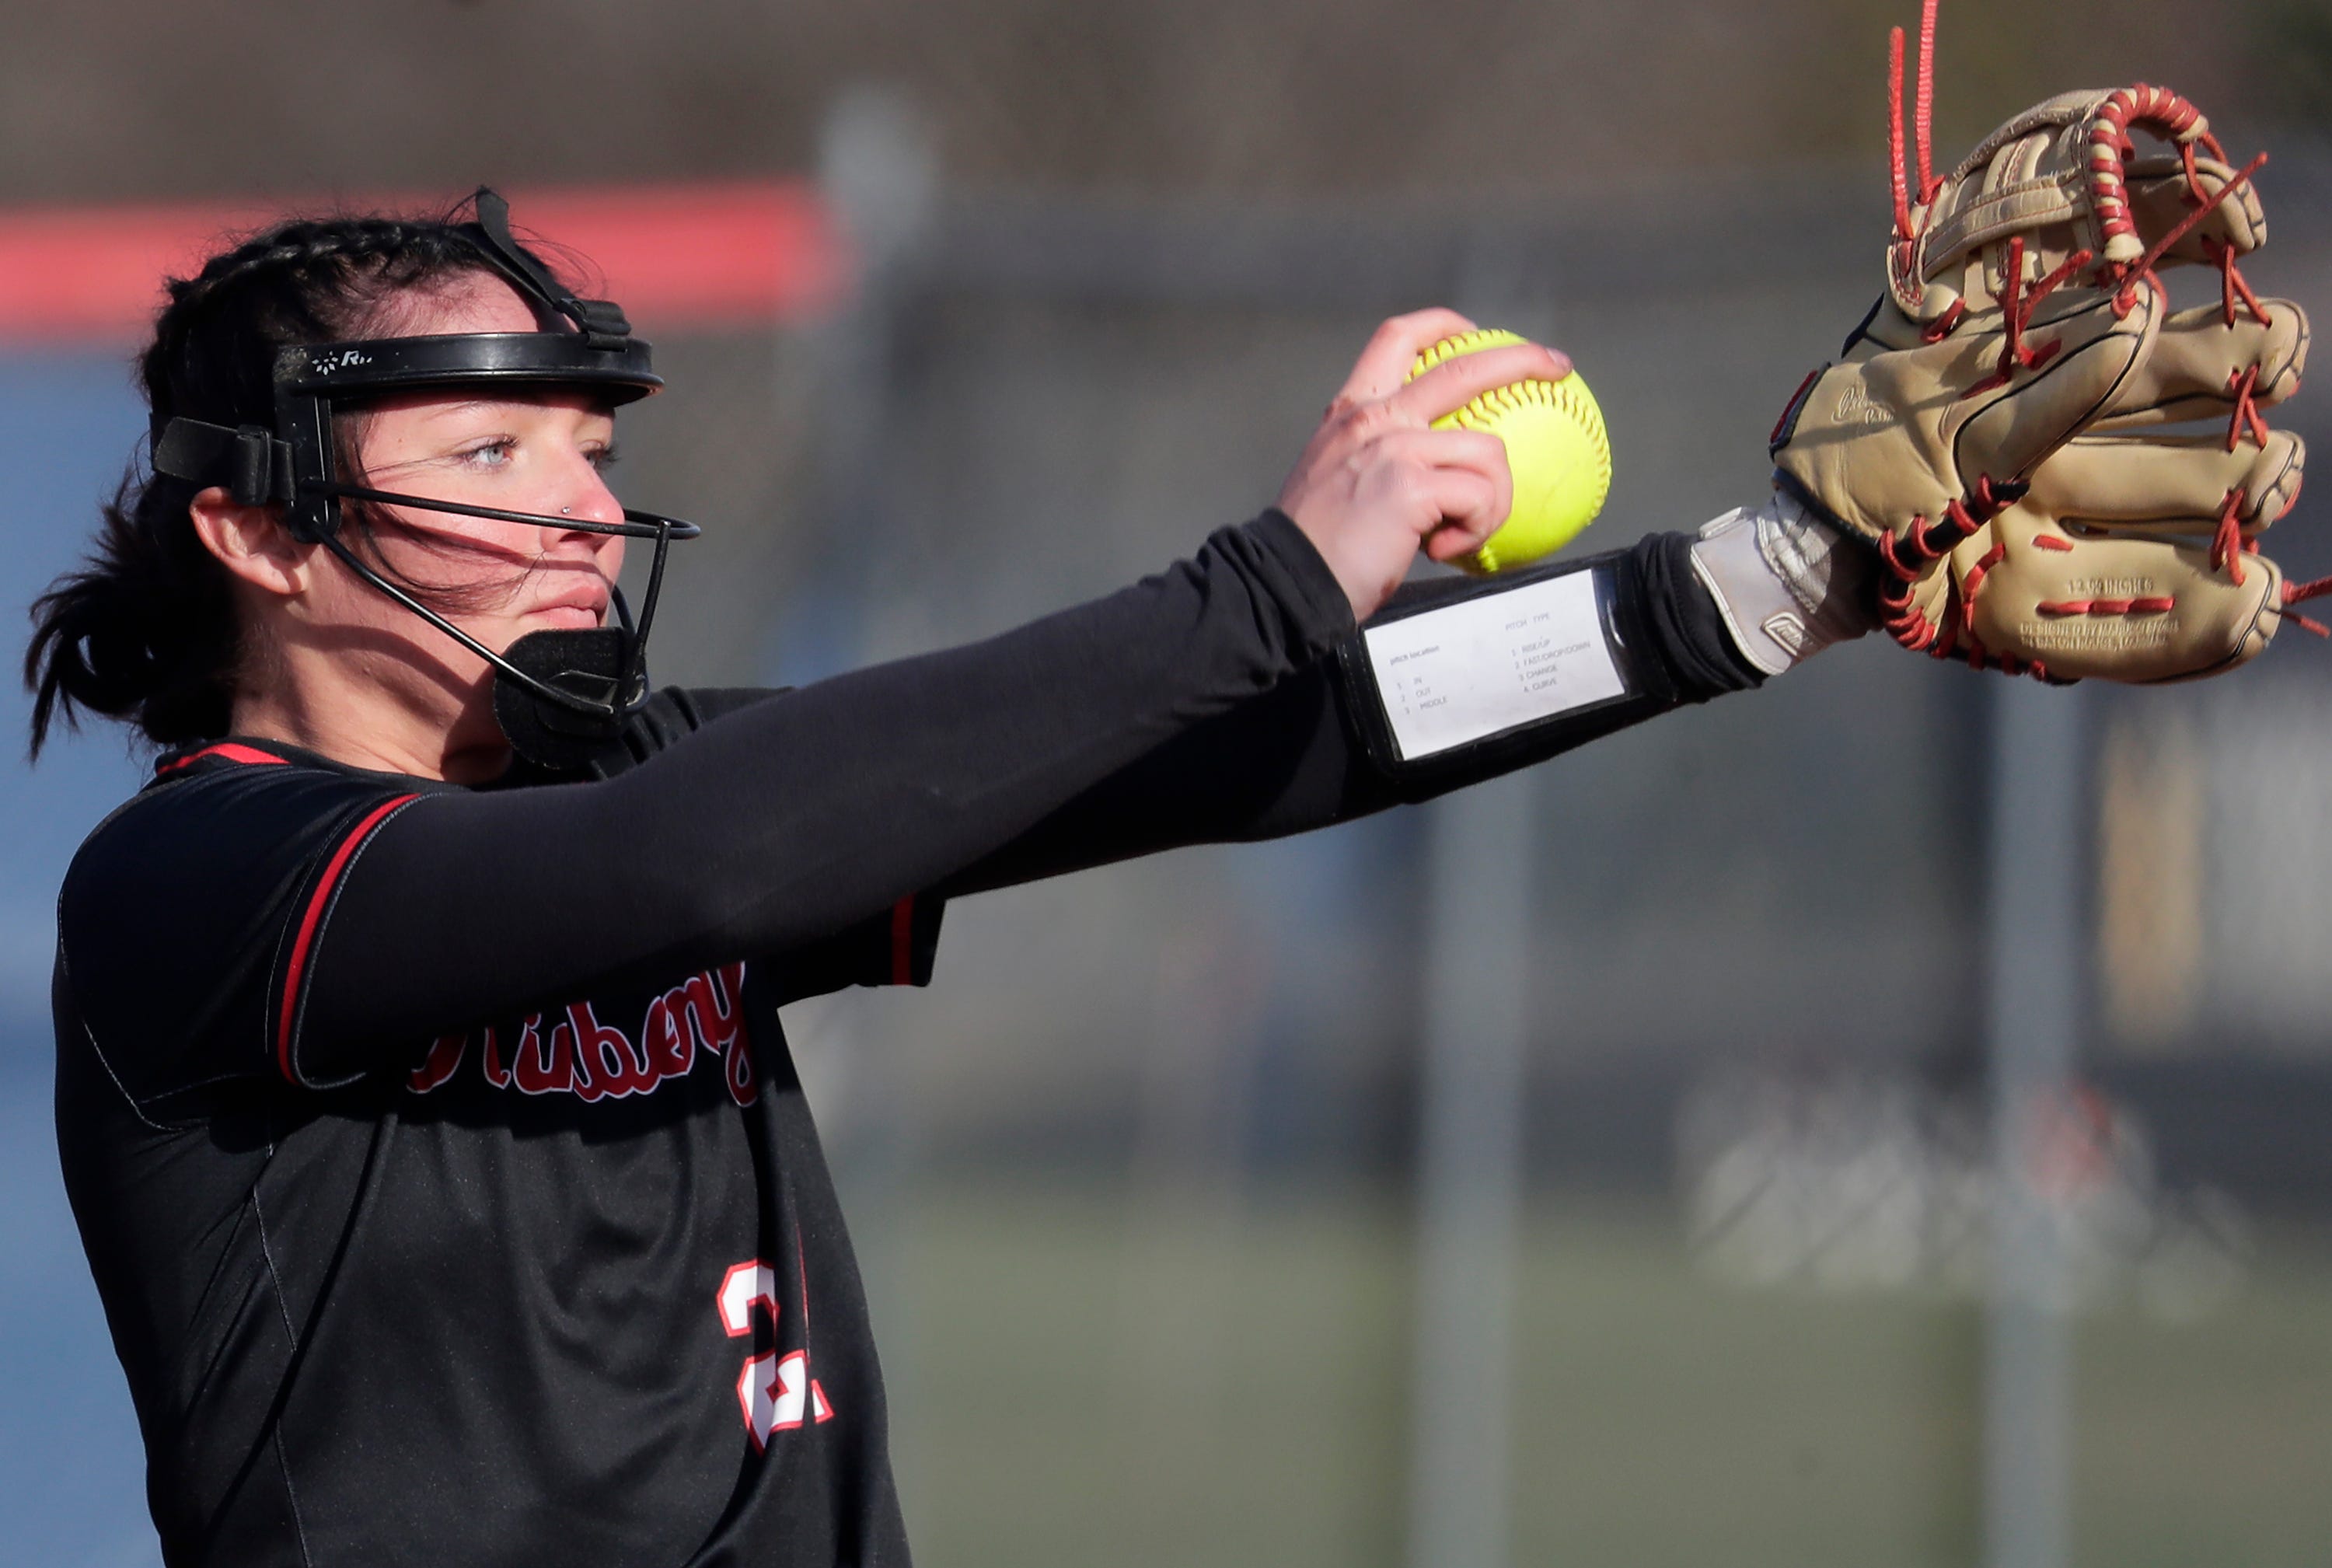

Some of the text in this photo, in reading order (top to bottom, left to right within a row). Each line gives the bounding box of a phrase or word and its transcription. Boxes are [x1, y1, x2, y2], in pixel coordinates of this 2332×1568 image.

[1505, 613, 1549, 630] PITCH TYPE
[1526, 665, 1557, 679] CHANGE
[1532, 678, 1556, 690] CURVE
[1416, 688, 1430, 698] OUT
[1419, 697, 1447, 710] MIDDLE
